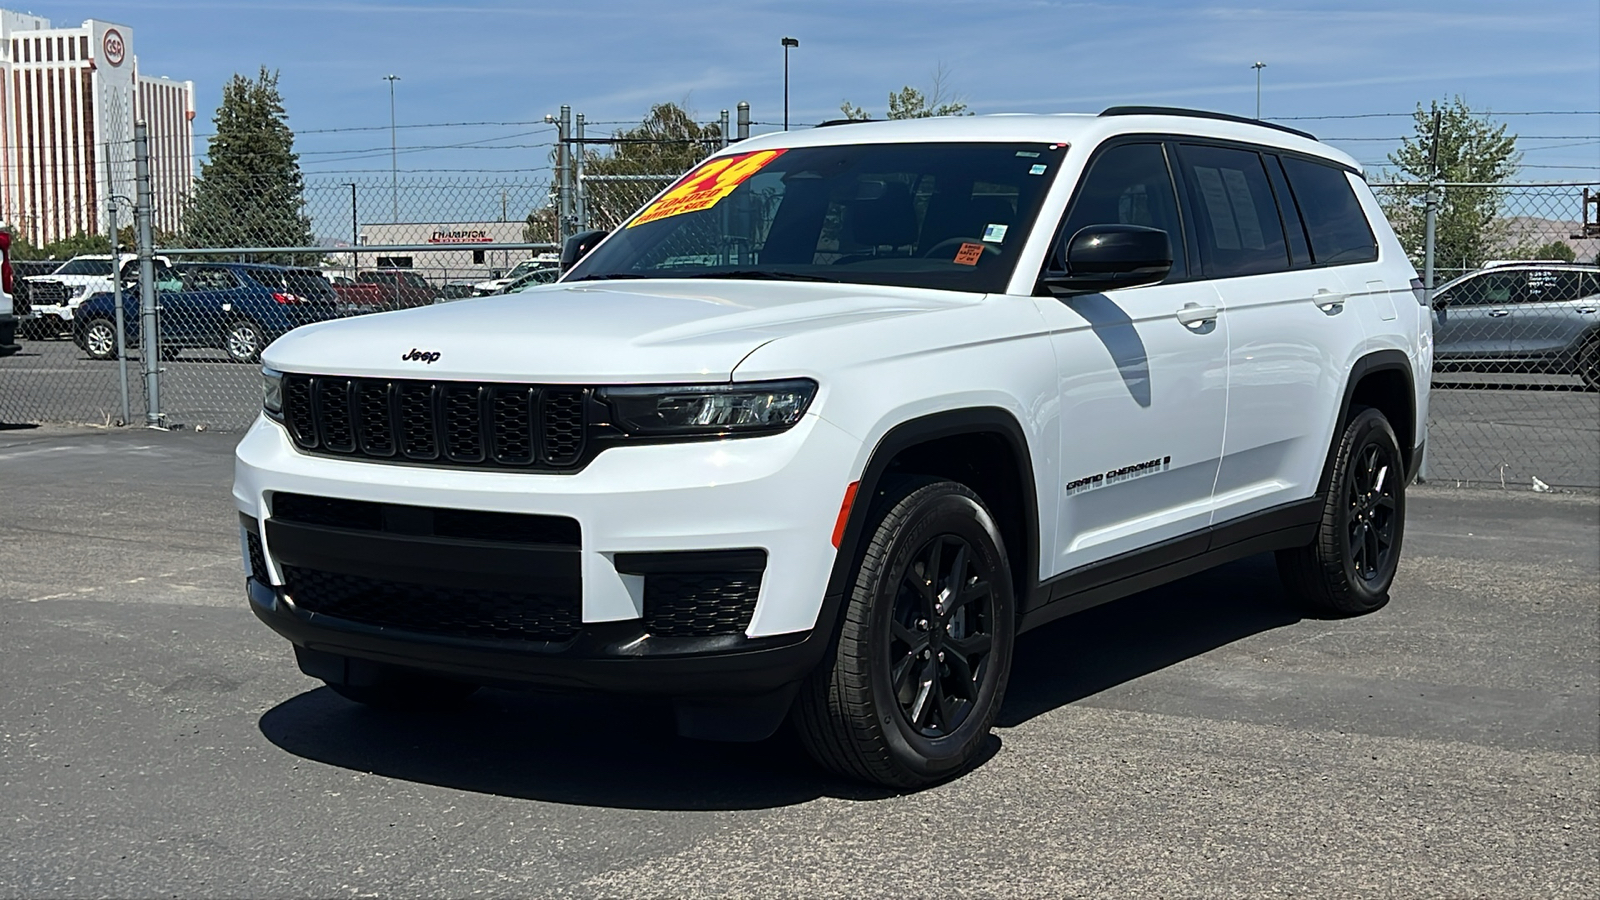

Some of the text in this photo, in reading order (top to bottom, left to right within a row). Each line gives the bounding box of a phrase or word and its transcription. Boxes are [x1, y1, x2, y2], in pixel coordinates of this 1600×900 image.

[106, 39, 121, 57] GSR
[654, 188, 723, 211] LOADED
[633, 199, 714, 225] FAMILY SIZE
[432, 230, 486, 241] CHAMPION
[402, 348, 441, 364] Jeep
[1066, 474, 1103, 490] GRAND
[1106, 458, 1162, 478] CHEROKEE
